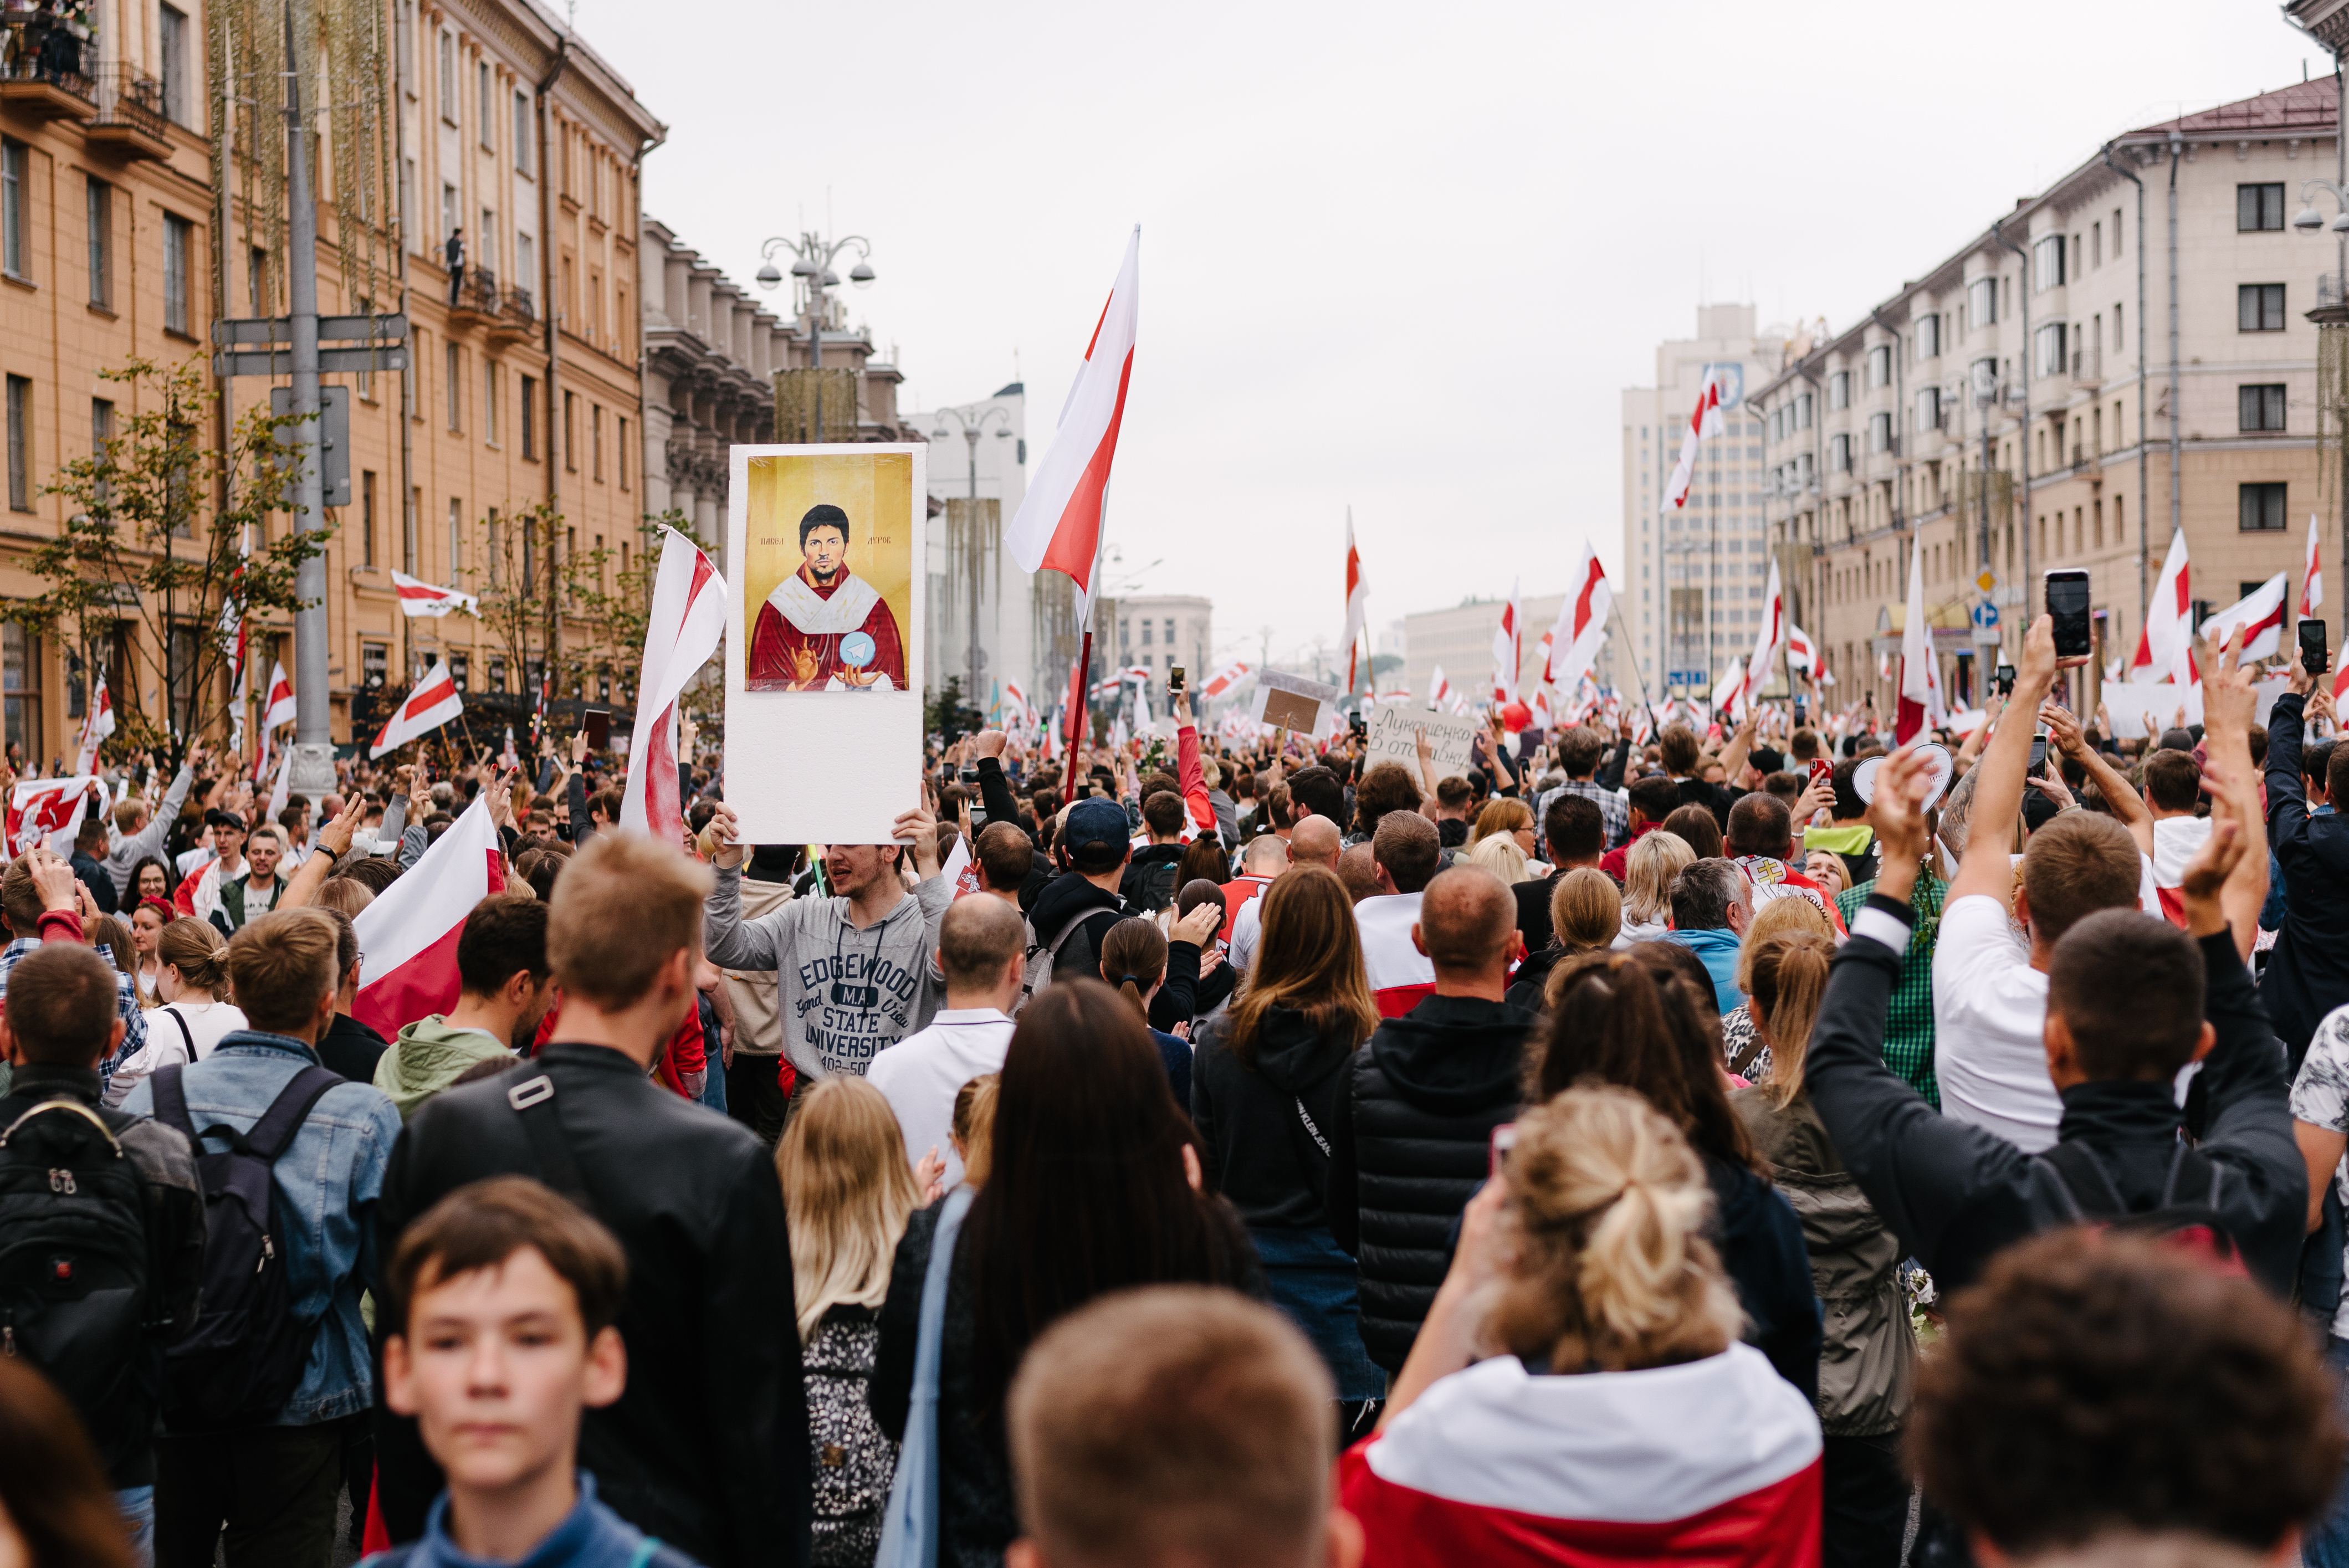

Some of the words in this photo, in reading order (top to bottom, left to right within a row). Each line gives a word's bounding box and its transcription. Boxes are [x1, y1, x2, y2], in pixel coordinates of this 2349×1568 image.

[1376, 709, 1470, 741] Лукашенко
[799, 954, 917, 1002] EDGEWOOD
[822, 1006, 881, 1033] STATE
[881, 998, 910, 1028] View
[821, 1055, 871, 1076] 402-50
[1300, 1113, 1319, 1136] KLEIN
